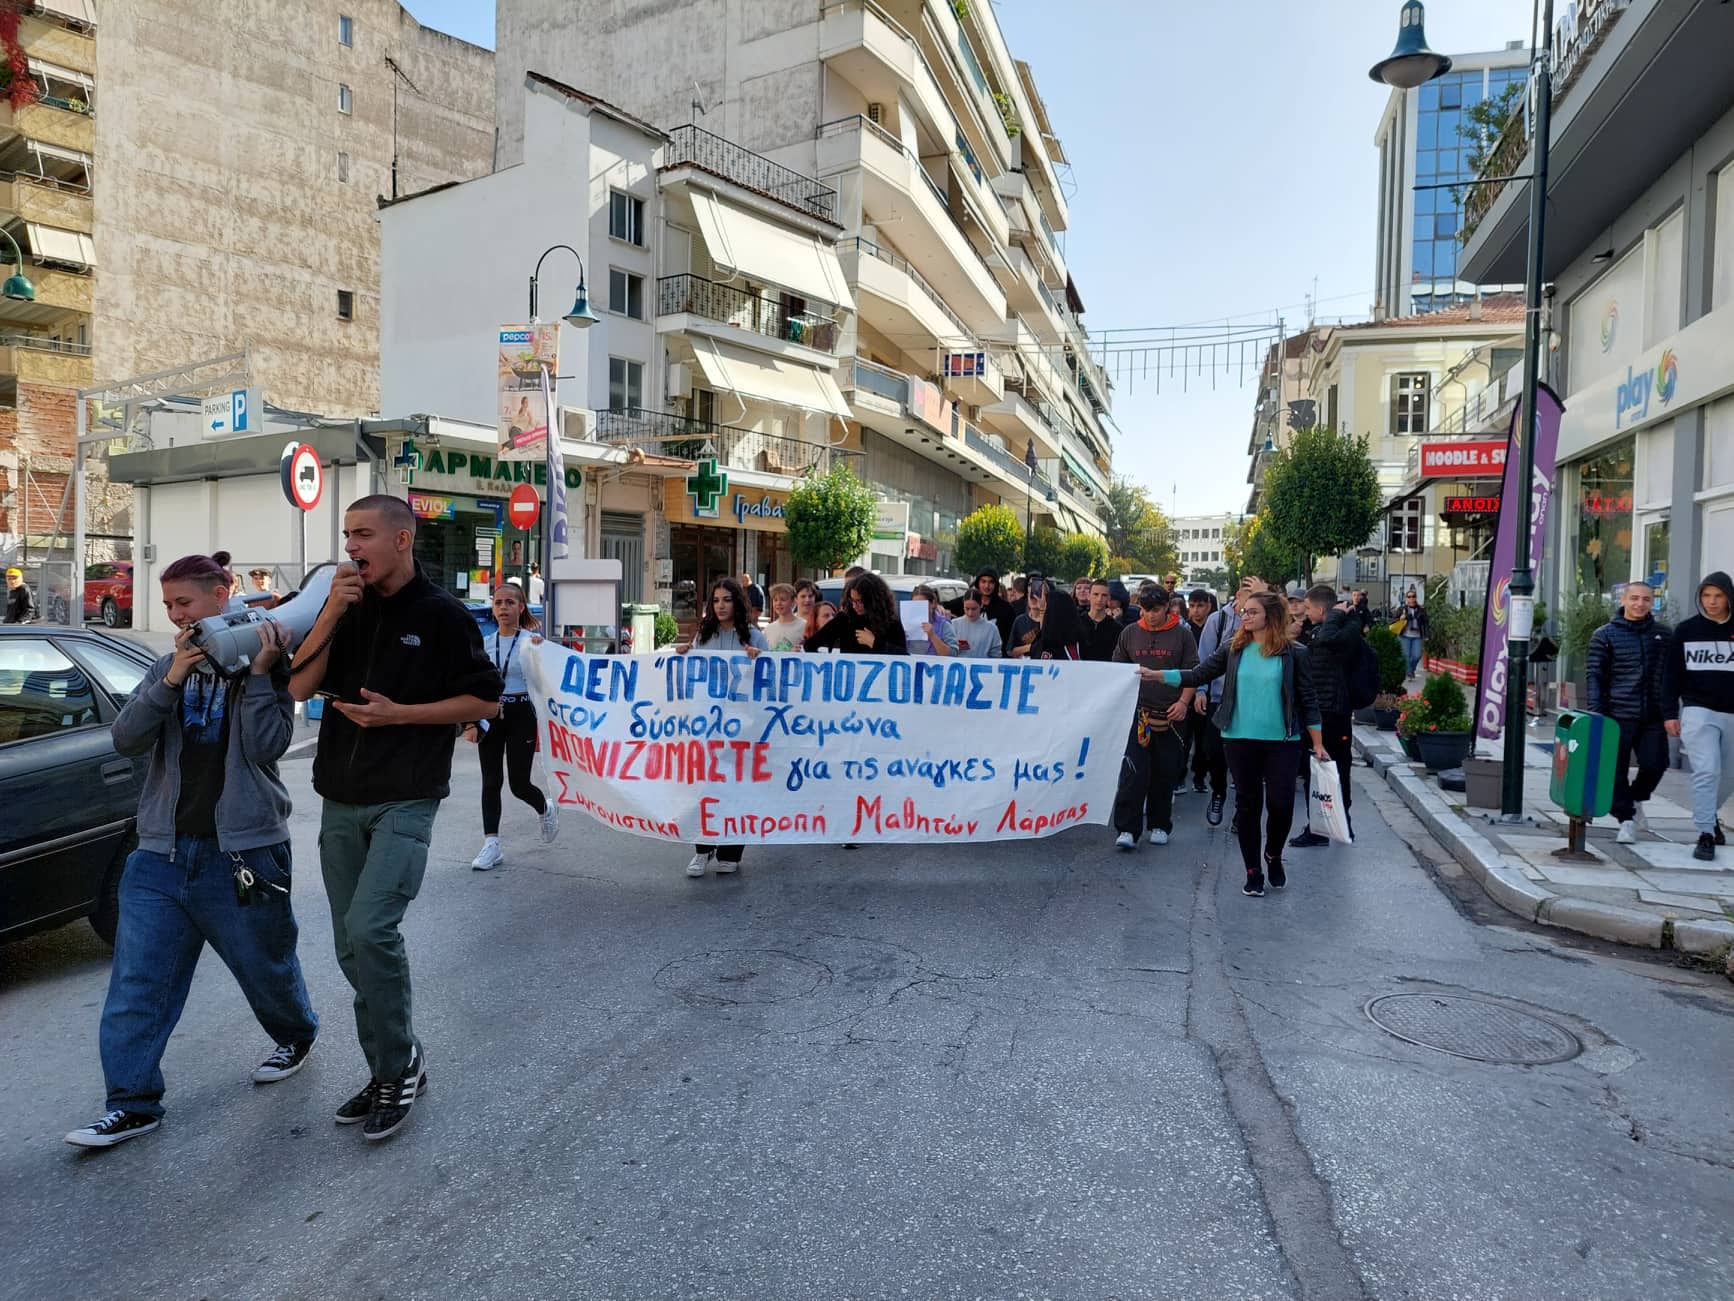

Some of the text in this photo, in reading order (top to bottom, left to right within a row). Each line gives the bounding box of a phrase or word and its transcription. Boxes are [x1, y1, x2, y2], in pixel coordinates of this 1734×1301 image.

[503, 333, 530, 342] pepco
[204, 401, 231, 417] PARKING
[234, 393, 246, 428] P
[1616, 365, 1655, 429] play
[1425, 450, 1478, 466] NOODLE
[1480, 453, 1488, 465] &
[411, 498, 451, 514] EVIOL
[733, 493, 785, 524] Γραβά
[560, 655, 638, 701] ΔΕΝ
[548, 698, 607, 730] στον
[630, 700, 741, 740] δύσκολο
[548, 719, 774, 785] ΑΓΩΝΙΖΟΜΑΣΤΕ
[786, 757, 831, 792] για
[842, 757, 879, 782] τις
[887, 751, 996, 788] ανάγκες
[700, 796, 827, 838] Επιτροπή
[851, 794, 979, 836] Μαθητών
[996, 799, 1088, 835] Λάρισας
